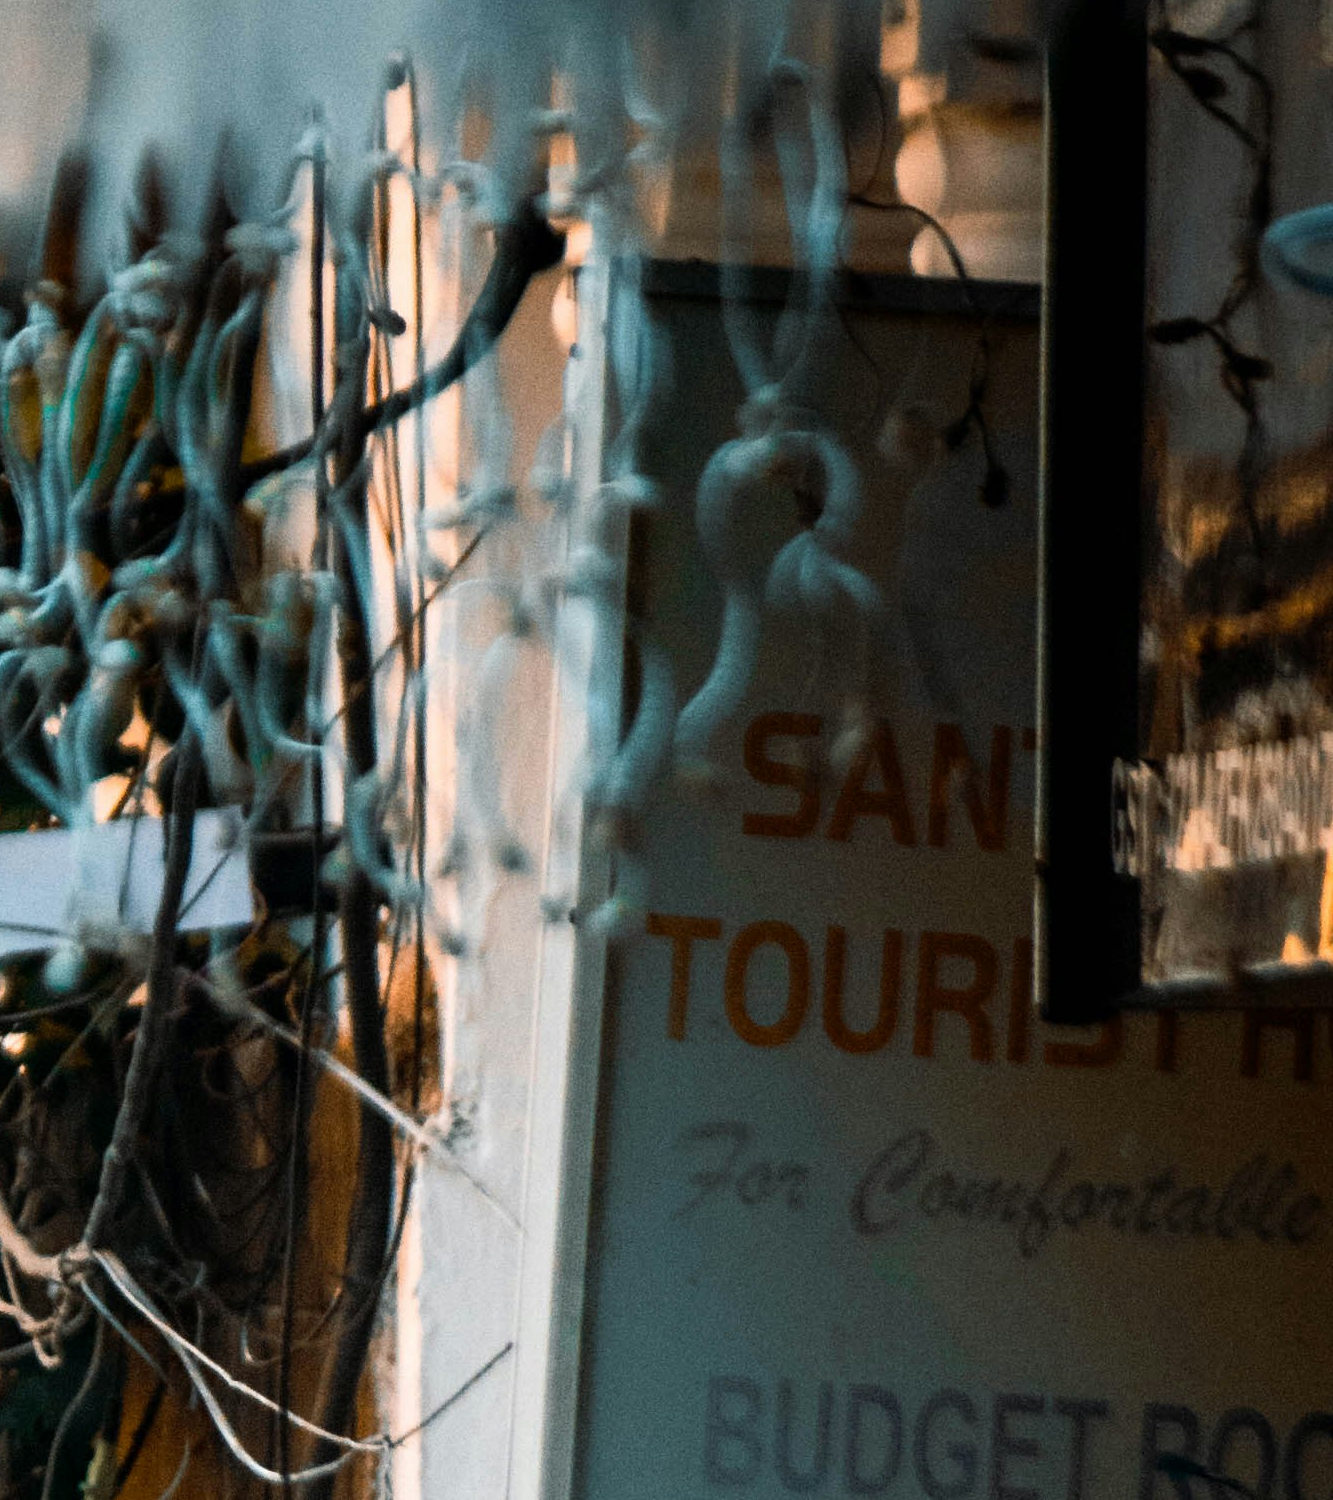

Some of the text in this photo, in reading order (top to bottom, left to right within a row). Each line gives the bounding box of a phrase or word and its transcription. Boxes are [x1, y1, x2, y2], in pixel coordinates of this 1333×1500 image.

[742, 710, 1035, 851] SAN
[671, 1121, 1326, 1258] For Comfortable
